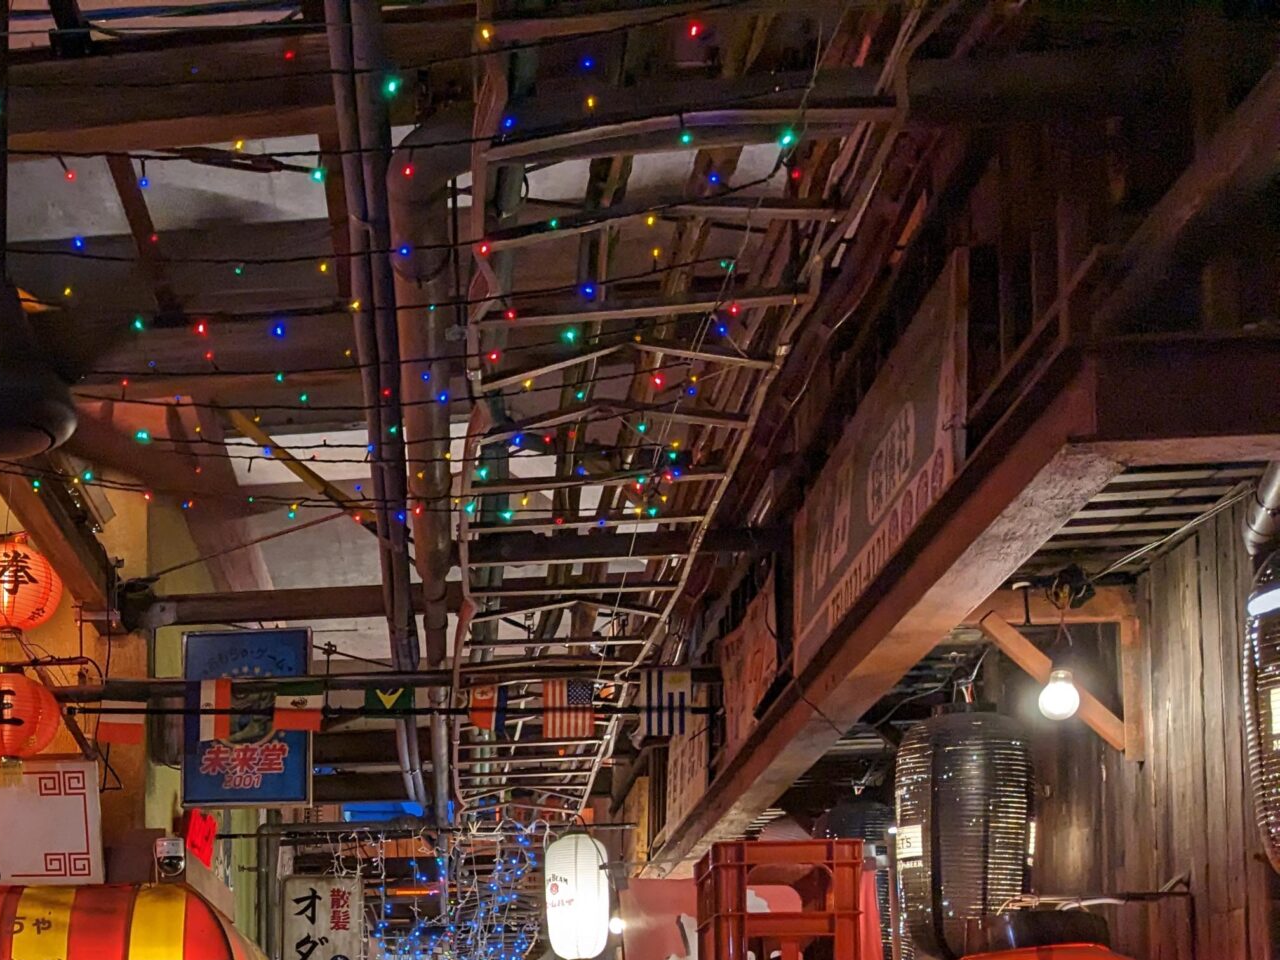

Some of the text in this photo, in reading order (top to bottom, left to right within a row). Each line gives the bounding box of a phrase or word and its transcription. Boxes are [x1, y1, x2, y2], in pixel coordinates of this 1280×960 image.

[200, 742, 290, 776] 未来堂
[223, 774, 263, 789] 2001
[329, 887, 352, 931] 散髪
